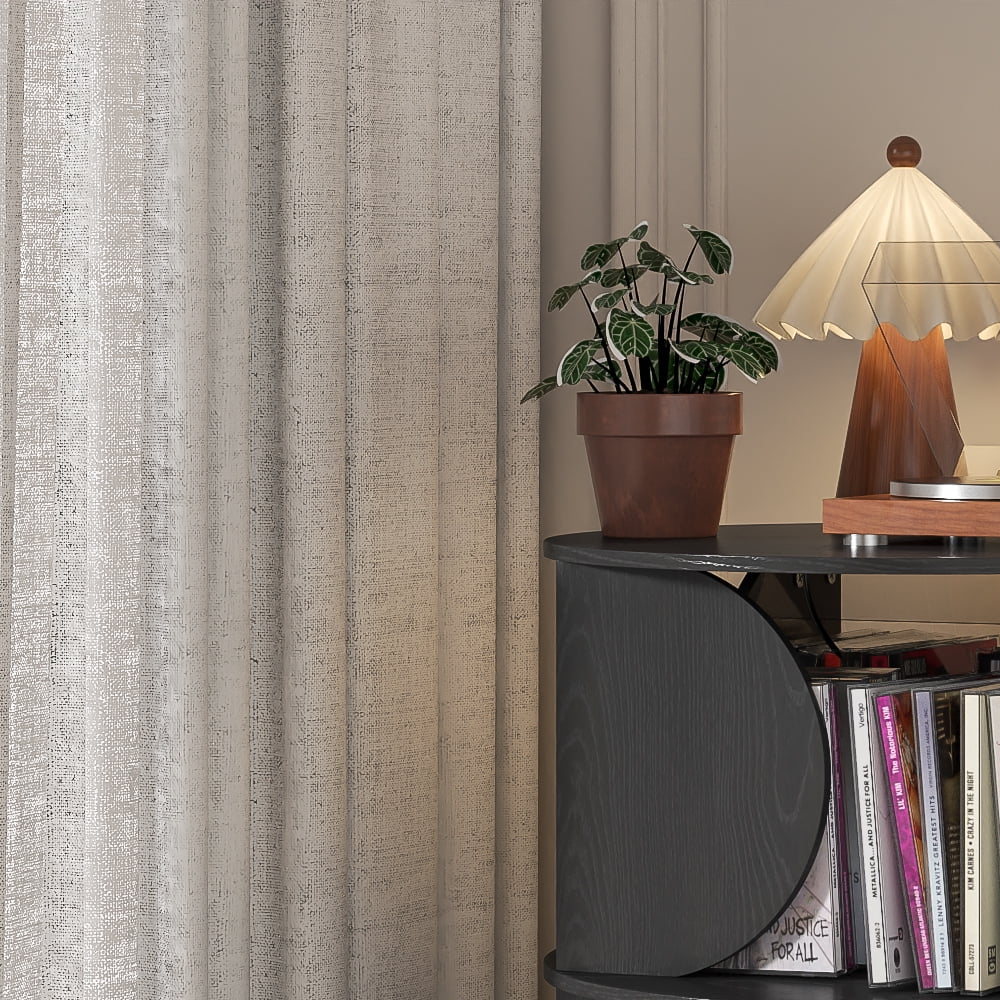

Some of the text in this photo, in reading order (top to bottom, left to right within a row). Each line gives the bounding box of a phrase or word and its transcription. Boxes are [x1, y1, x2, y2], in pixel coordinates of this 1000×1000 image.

[857, 702, 866, 728] Vertigo
[882, 706, 891, 720] KIM
[885, 721, 898, 759] Notorious
[891, 760, 900, 775] The
[894, 782, 904, 796] KIM
[864, 797, 873, 828] JUSTICE
[930, 817, 939, 858] GREATEST
[966, 770, 975, 891] KIM CARNES CRAZY IN THE NIGHT
[934, 861, 942, 896] KRAVITZ
[936, 900, 945, 927] LENNY
[780, 916, 829, 938] JUSTICE
[771, 941, 819, 963] FOR ALL
